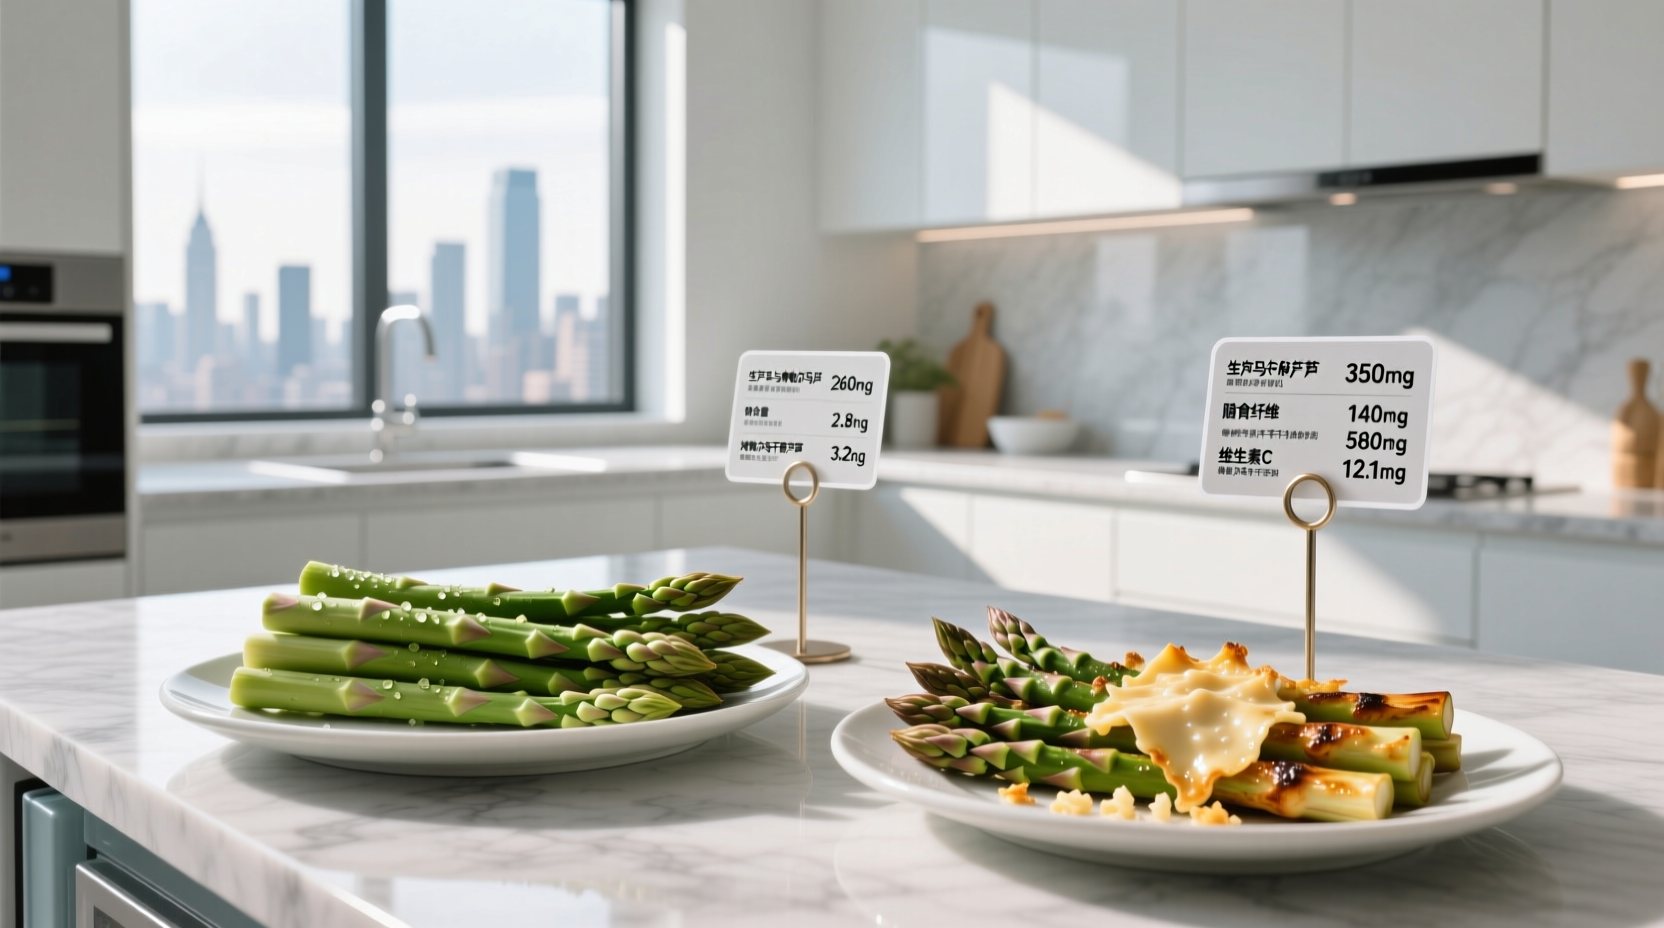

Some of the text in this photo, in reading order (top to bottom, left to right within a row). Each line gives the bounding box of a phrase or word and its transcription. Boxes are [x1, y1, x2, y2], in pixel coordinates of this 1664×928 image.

[830, 375, 874, 396] 260ng
[1345, 363, 1415, 389] 350mg
[831, 412, 868, 433] 2.8ng
[1348, 404, 1408, 429] 140mg
[1345, 431, 1407, 456] 580mg
[830, 446, 866, 467] 3.2ng
[1342, 459, 1406, 486] 12.1mg
